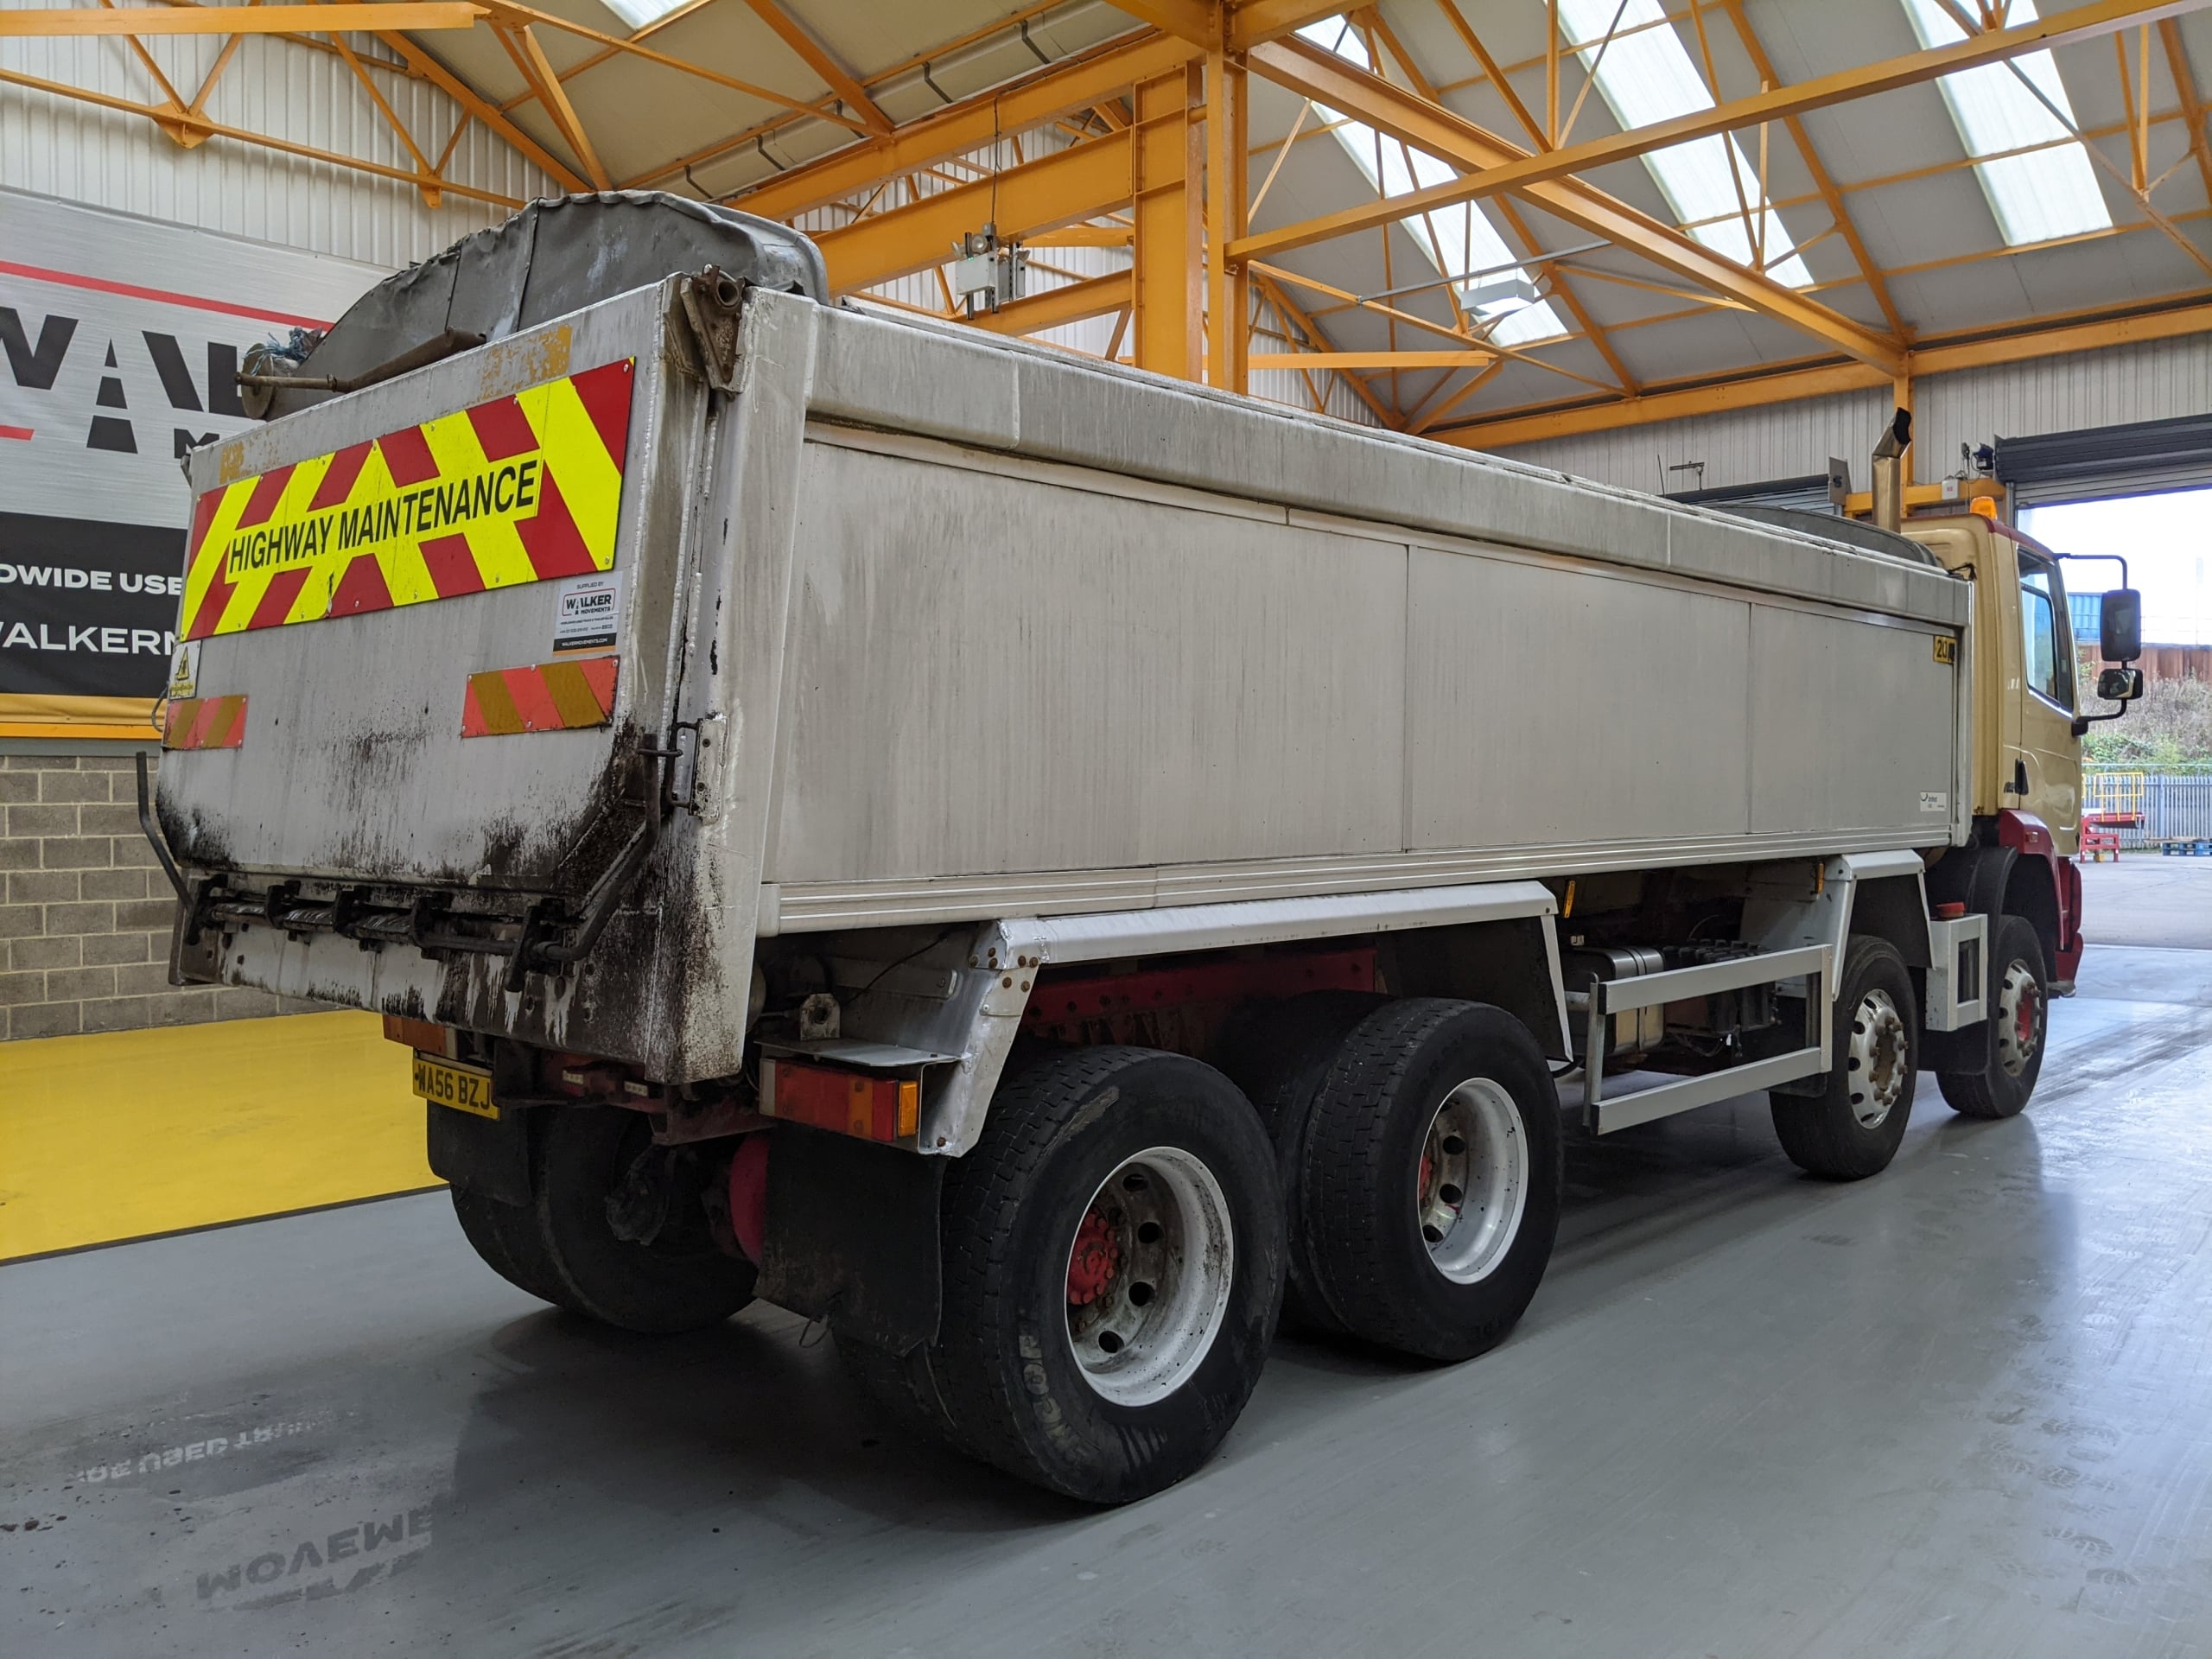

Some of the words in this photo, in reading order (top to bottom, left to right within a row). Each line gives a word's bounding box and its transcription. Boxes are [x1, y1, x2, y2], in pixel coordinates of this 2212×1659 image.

[229, 514, 334, 574] HIGHWAY
[338, 459, 537, 551] MAINTENANCE
[566, 594, 612, 614] WALKER
[0, 621, 175, 656] ALKER
